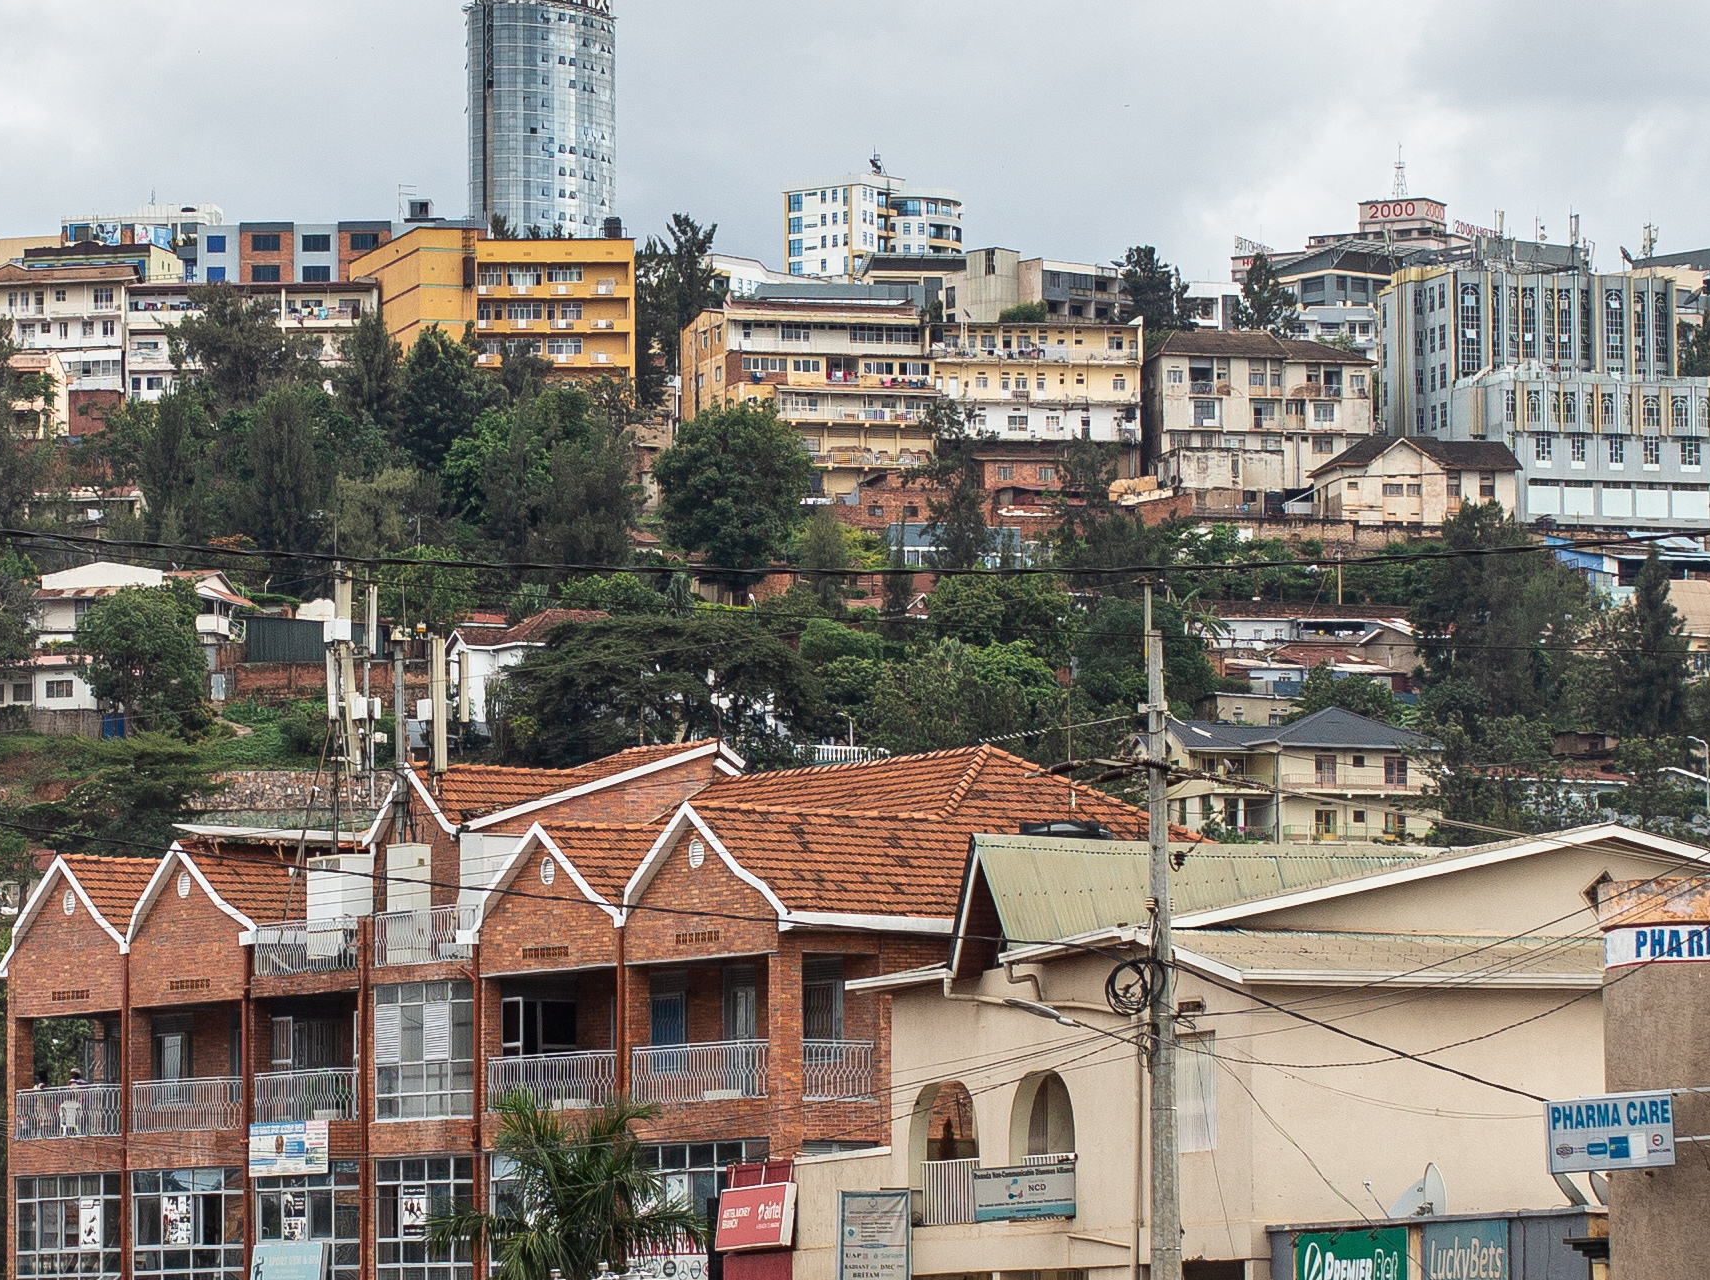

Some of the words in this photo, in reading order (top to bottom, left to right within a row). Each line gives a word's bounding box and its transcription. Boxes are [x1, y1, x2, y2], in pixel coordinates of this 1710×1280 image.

[1368, 201, 1416, 220] 2000
[1424, 201, 1445, 221] 2000
[1551, 1104, 1622, 1131] PHARMA
[1627, 1099, 1671, 1126] CARE
[1028, 1183, 1046, 1192] NCD
[764, 1200, 782, 1220] airtel
